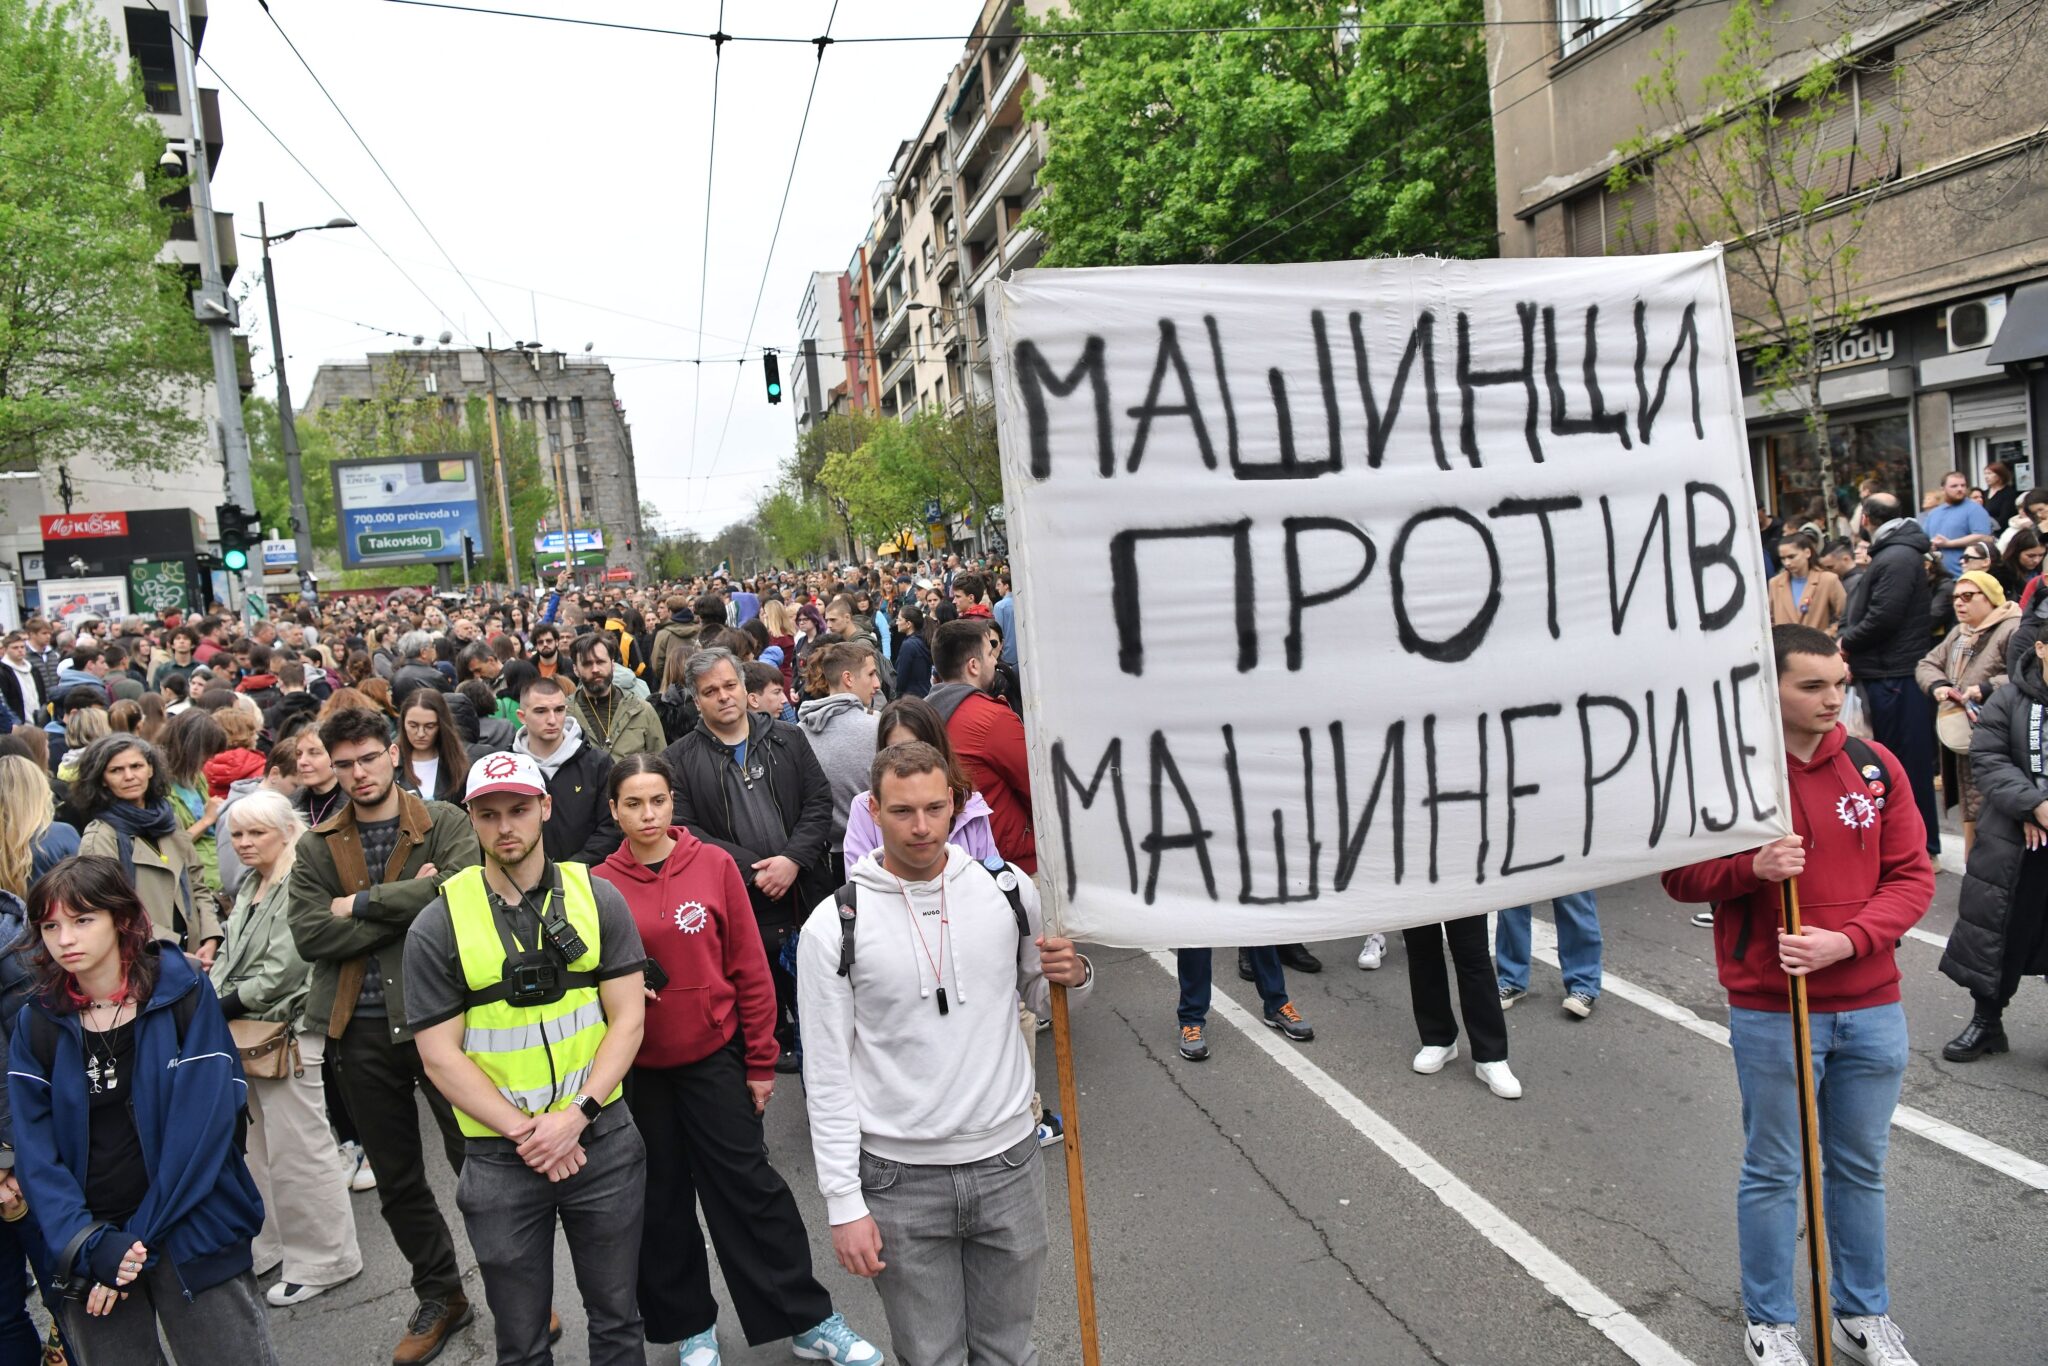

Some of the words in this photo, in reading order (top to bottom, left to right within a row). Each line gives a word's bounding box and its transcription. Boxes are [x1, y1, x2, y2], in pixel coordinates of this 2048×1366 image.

[1013, 299, 1705, 481] МАШИНЦИ
[354, 513, 395, 524] 700.000
[397, 509, 450, 524] proizvoda
[452, 509, 459, 517] u
[367, 534, 433, 549] Takovskoj
[1108, 480, 1748, 677] ПРОТИВ
[1050, 662, 1778, 906] МАШИНЕРИЈЕ
